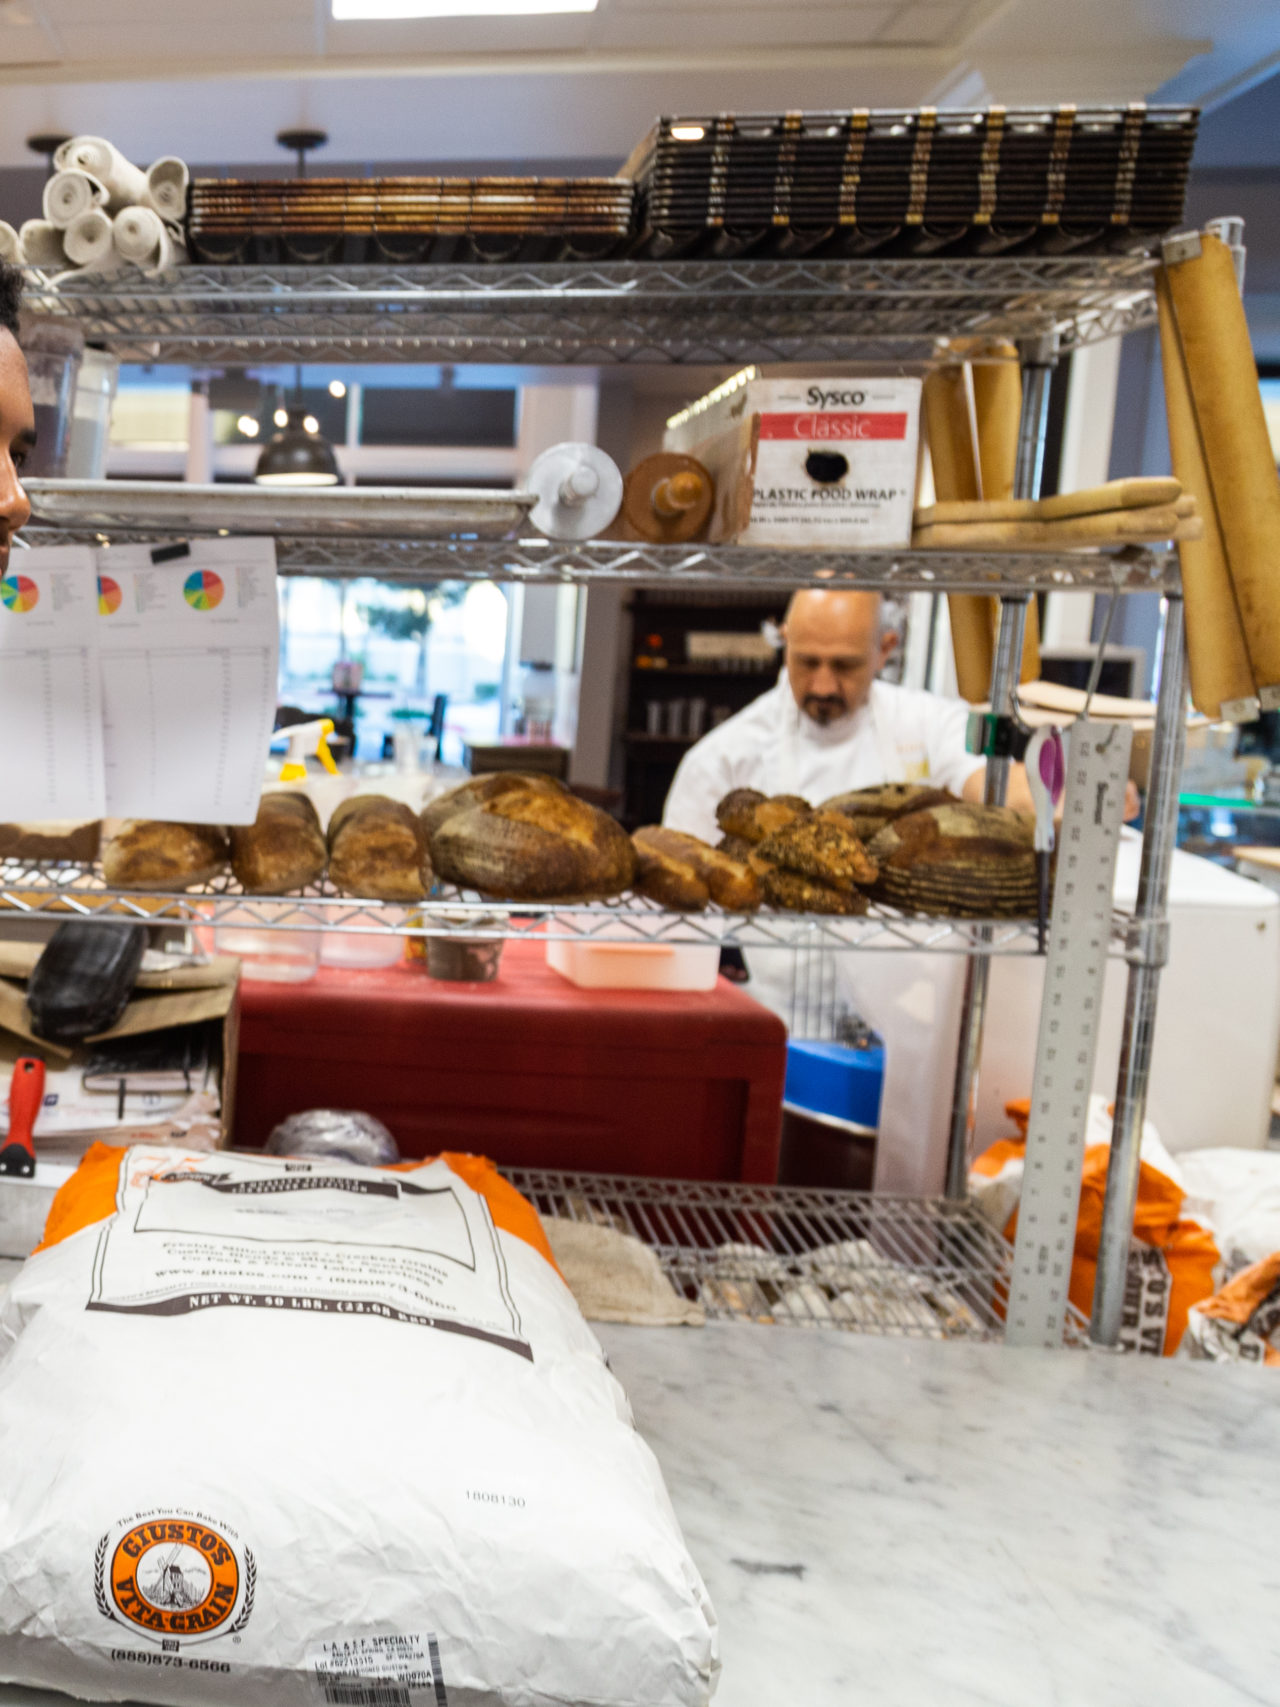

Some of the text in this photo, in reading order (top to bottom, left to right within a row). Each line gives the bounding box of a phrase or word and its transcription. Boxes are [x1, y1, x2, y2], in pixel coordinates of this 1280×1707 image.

[806, 386, 865, 410] Sysco
[793, 414, 871, 439] Classic
[752, 487, 897, 500] PLASTIC FOOD WRAP
[189, 1293, 222, 1309] NET
[228, 1293, 257, 1306] WT.
[116, 1507, 240, 1541] The Best You Can Bake With
[122, 1524, 231, 1566] GIUSTO'S
[371, 1634, 420, 1647] SPECIALTY
